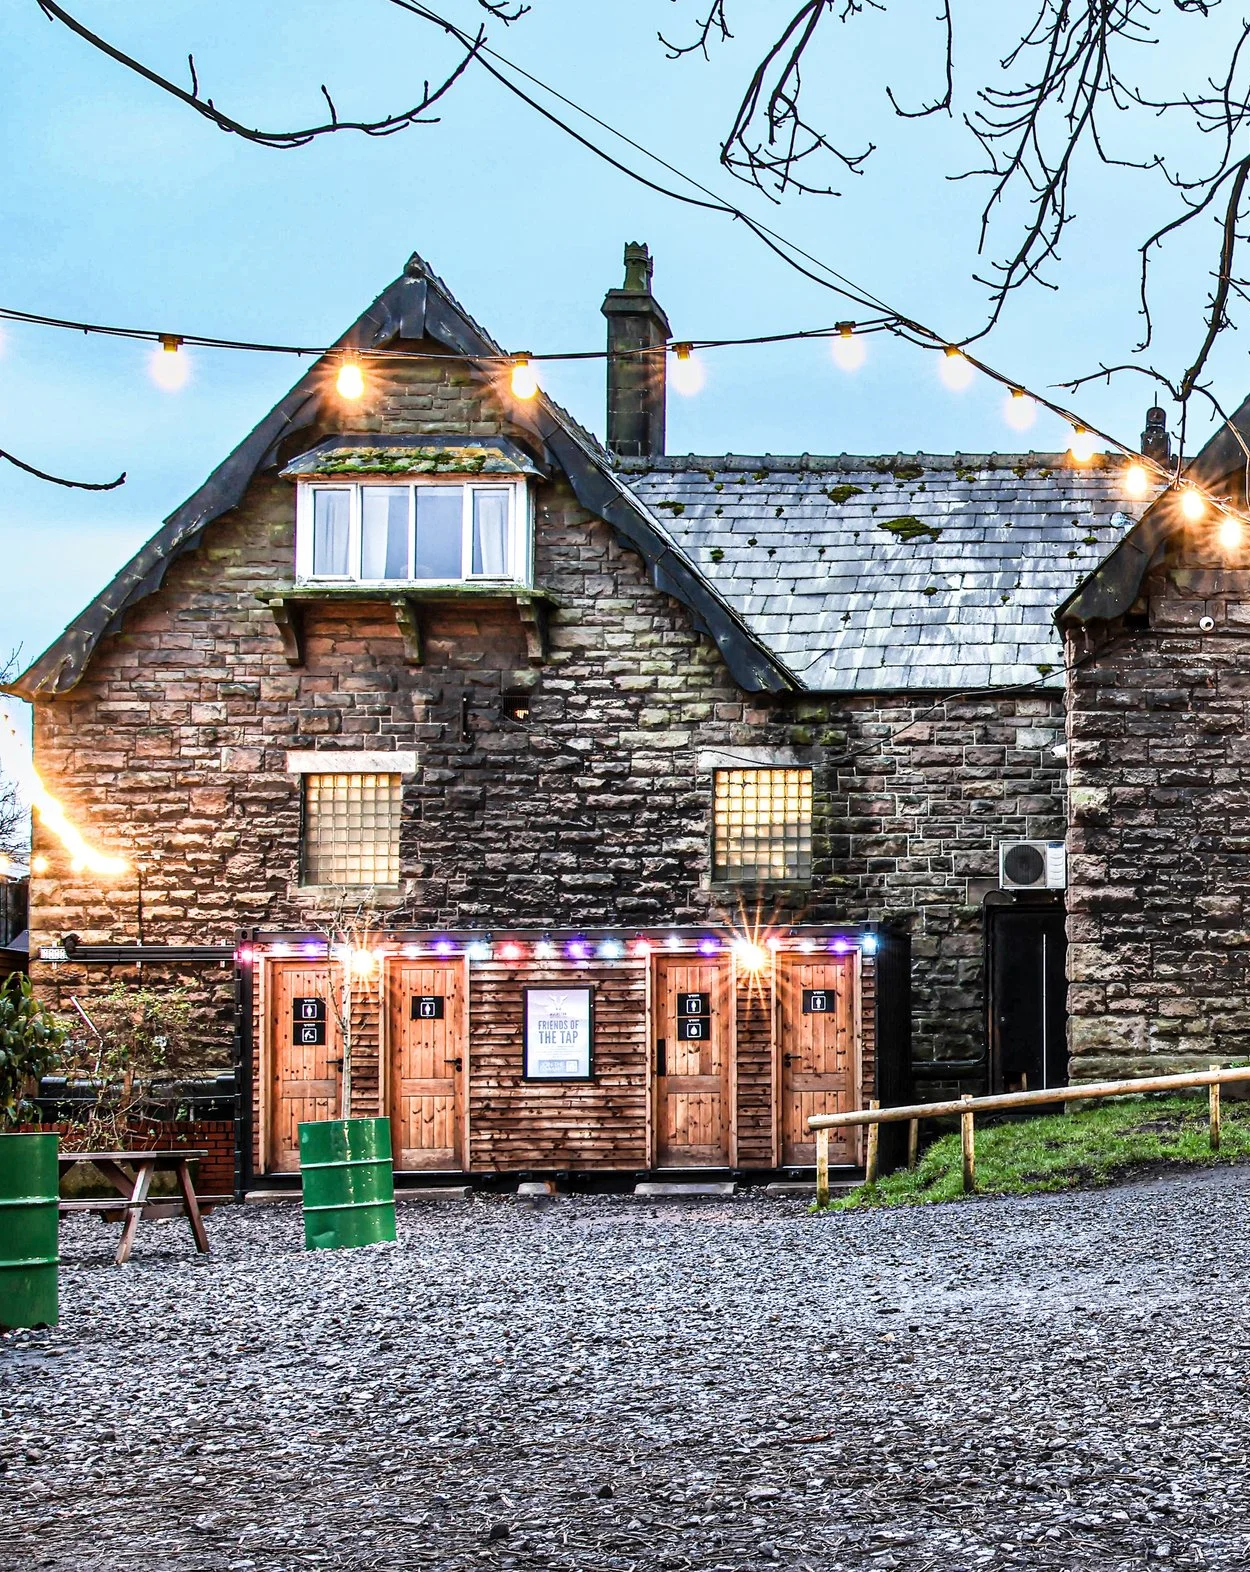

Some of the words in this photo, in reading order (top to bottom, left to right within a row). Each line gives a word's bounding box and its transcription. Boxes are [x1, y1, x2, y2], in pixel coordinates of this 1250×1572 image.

[538, 1020, 568, 1030] FRIENDS
[570, 1020, 580, 1030] OF
[538, 1031, 556, 1044] THE
[560, 1031, 579, 1044] TAP
